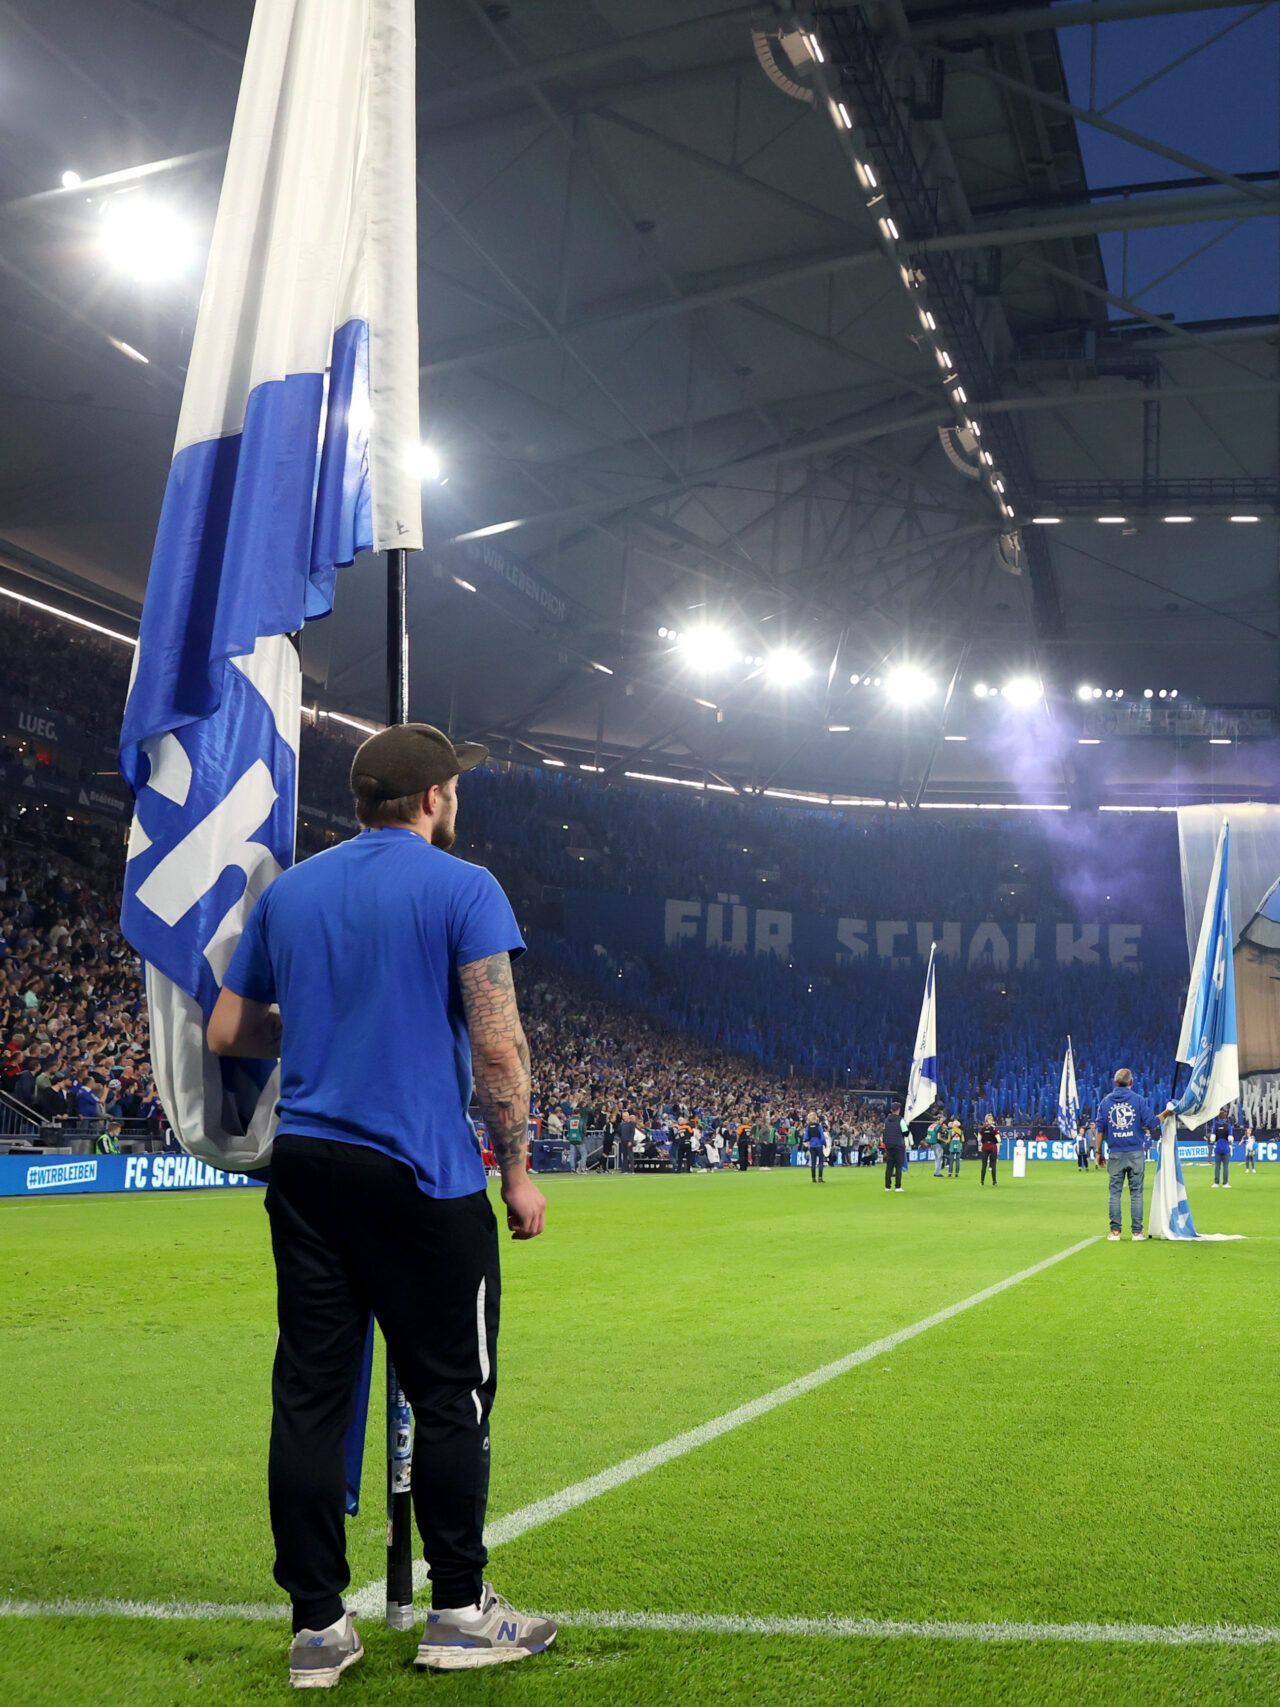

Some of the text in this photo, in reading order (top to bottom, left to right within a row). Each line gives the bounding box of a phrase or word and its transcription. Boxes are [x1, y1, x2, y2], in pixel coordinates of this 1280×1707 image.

[664, 892, 1144, 972] FÜR SCHALKE
[1028, 1140, 1048, 1160] FC
[1258, 1142, 1278, 1161] FC
[29, 1163, 96, 1187] #WIRBLEIBEN
[124, 1157, 148, 1189] FC
[497, 1620, 518, 1642] N
